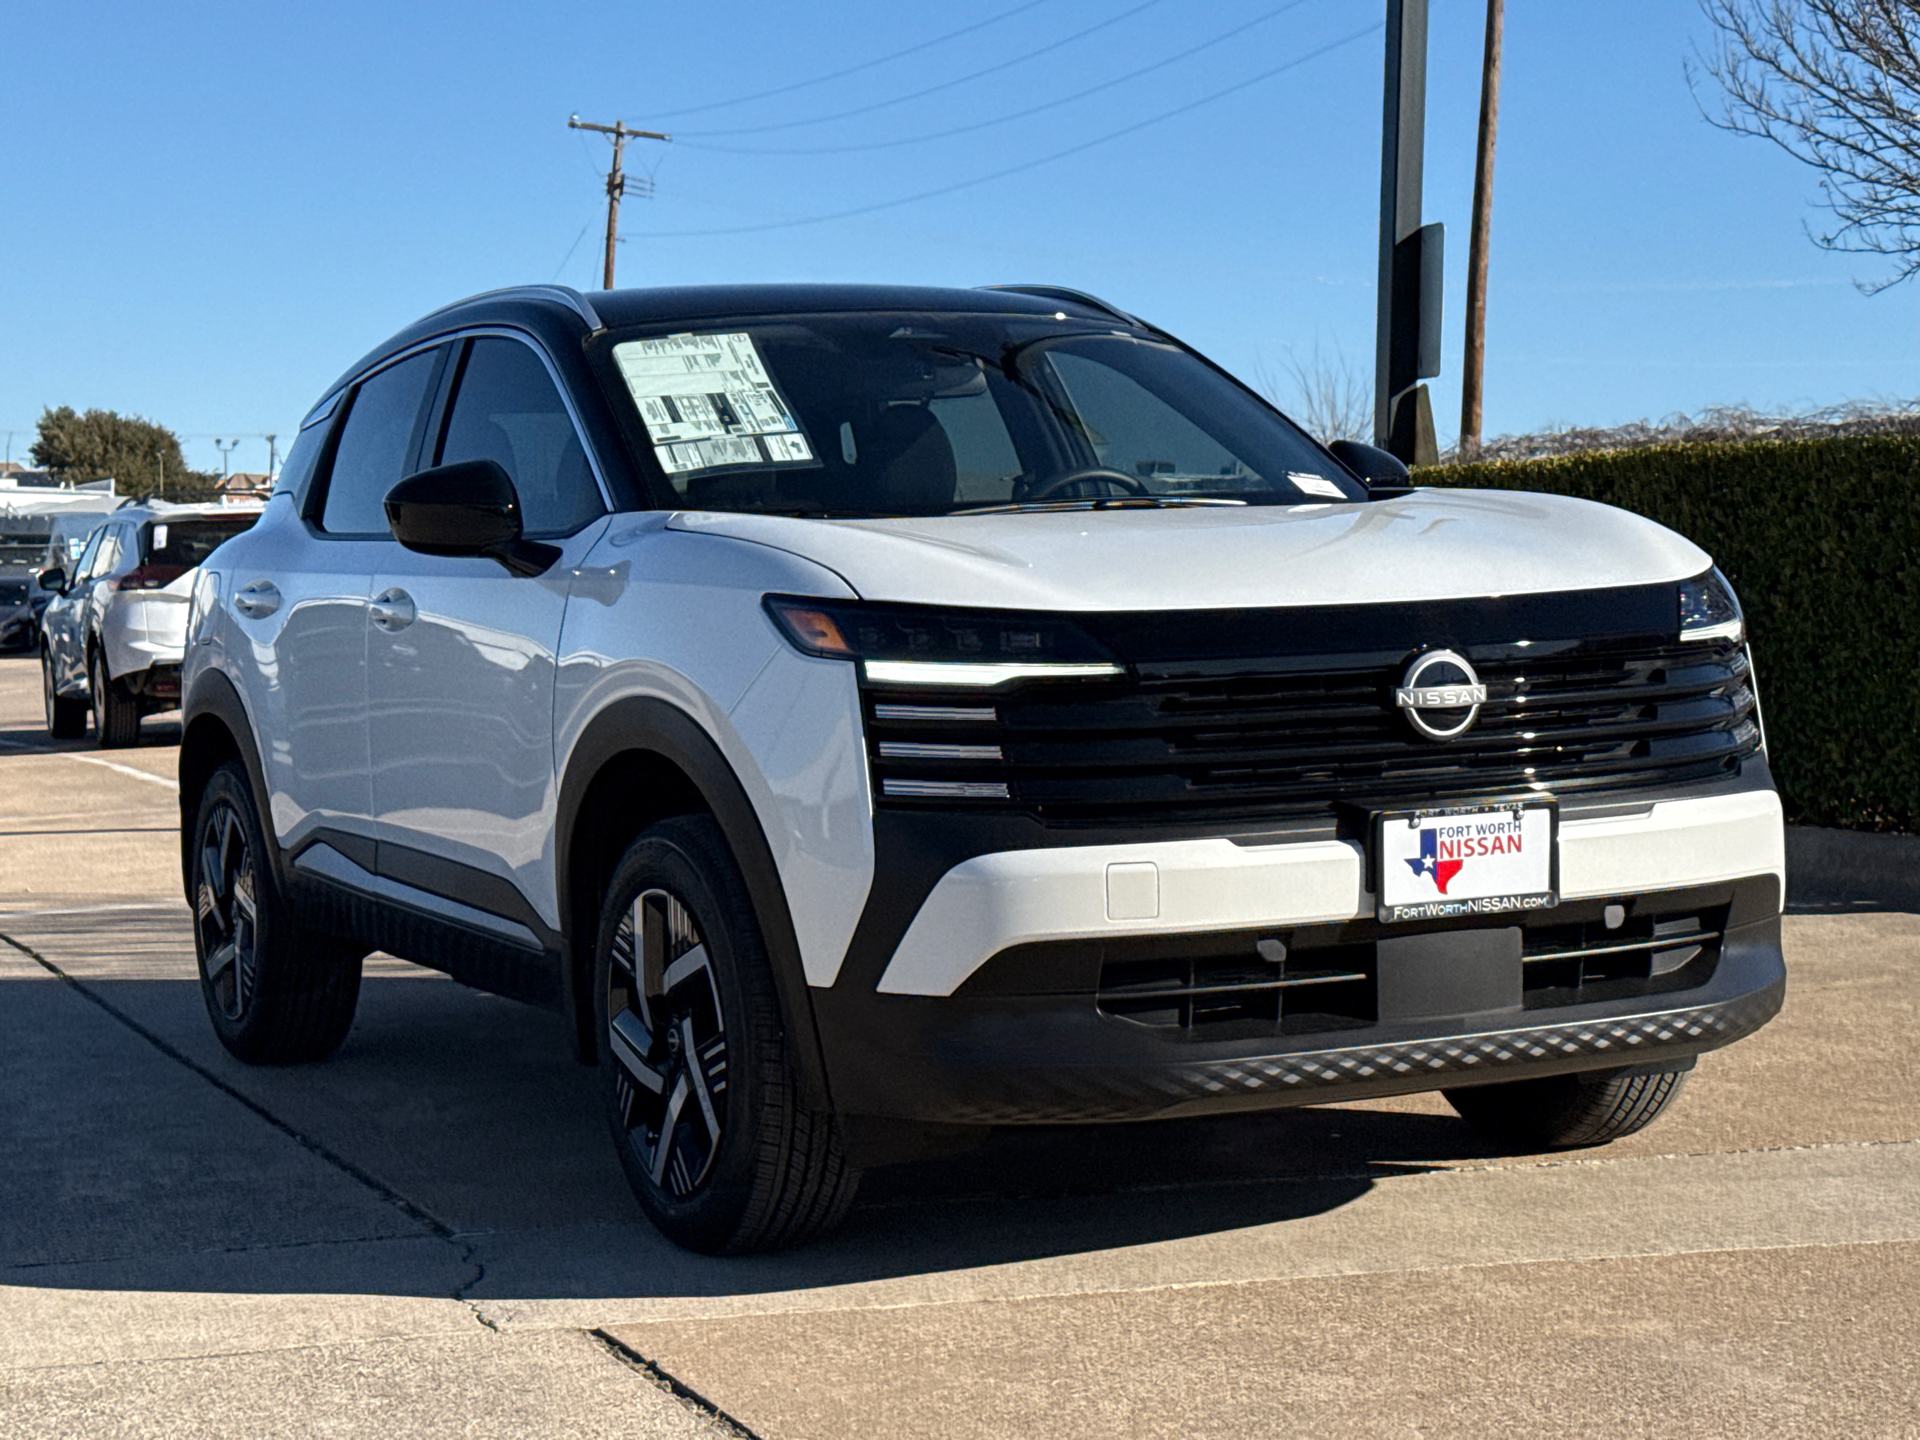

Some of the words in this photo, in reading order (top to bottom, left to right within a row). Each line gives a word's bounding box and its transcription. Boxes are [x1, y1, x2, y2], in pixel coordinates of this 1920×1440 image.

[1398, 687, 1486, 705] NISSAN
[1439, 825, 1472, 839] FORT
[1476, 820, 1522, 835] WORTH
[1439, 834, 1522, 859] NISSAN
